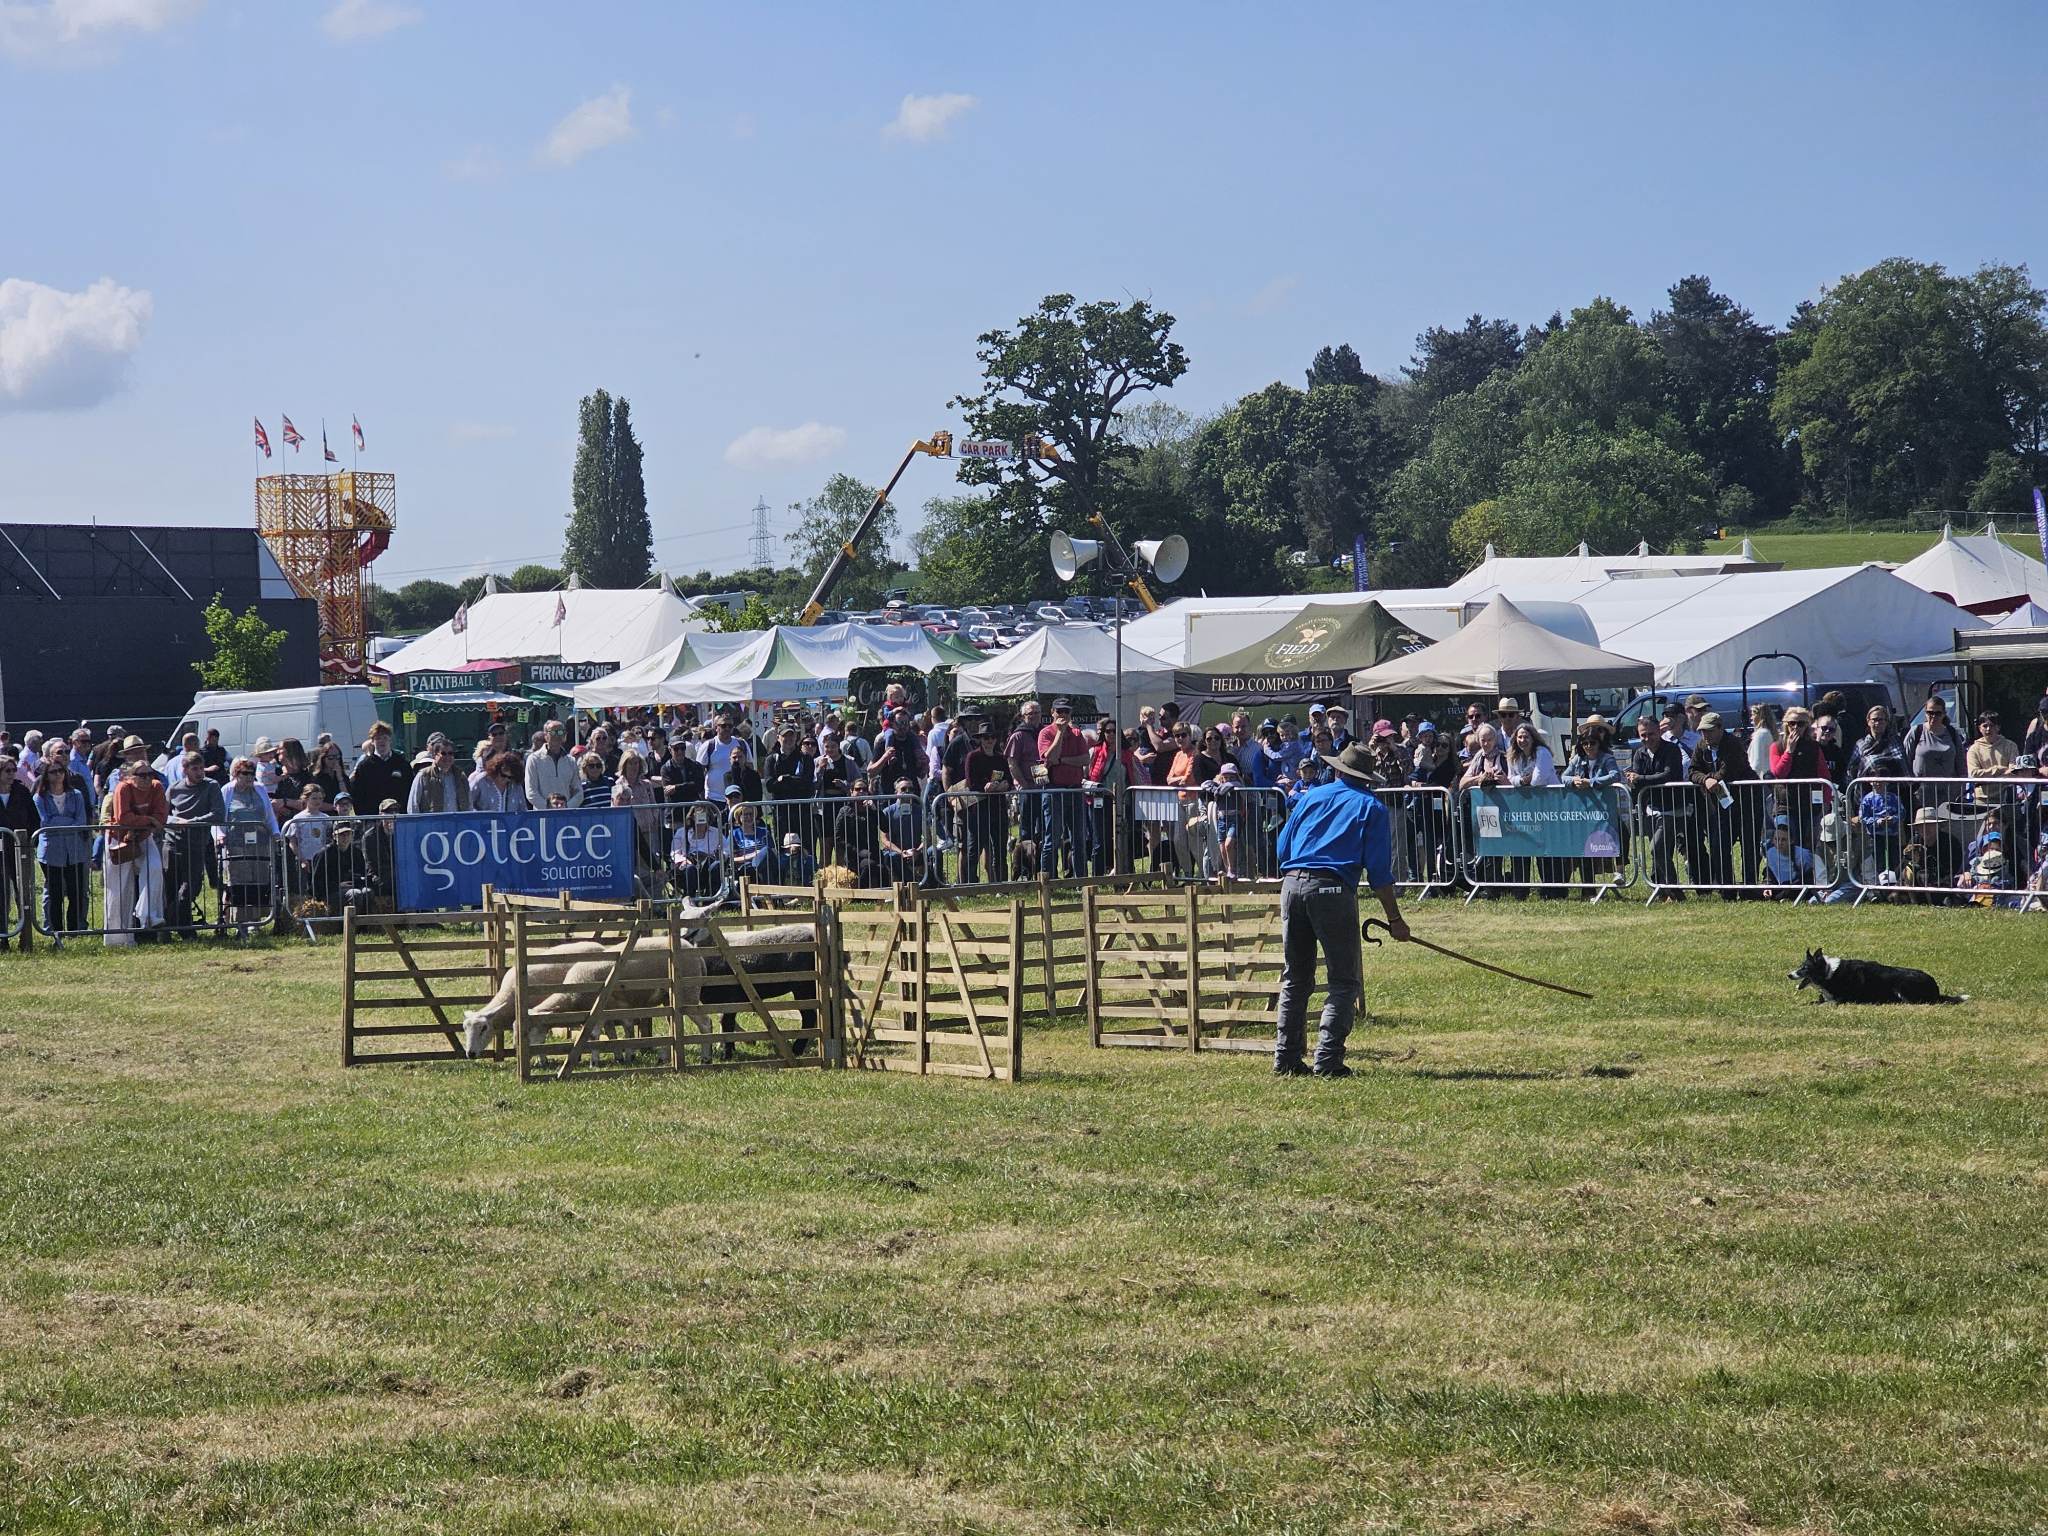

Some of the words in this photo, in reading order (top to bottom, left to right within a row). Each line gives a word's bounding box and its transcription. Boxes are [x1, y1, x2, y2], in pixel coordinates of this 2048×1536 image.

[961, 443, 980, 454] CAR
[982, 444, 1008, 456] PARK
[1274, 643, 1320, 655] FIELD
[530, 665, 574, 681] FIRING
[576, 664, 612, 680] ZONE
[409, 675, 474, 692] PAINTBALL
[1211, 678, 1245, 692] FIELD
[1247, 676, 1308, 692] COMPOST
[1310, 675, 1335, 690] LTD
[1480, 814, 1498, 829] FJG
[1504, 811, 1531, 822] FISHER
[1533, 811, 1558, 823] JONES
[1559, 810, 1609, 821] GREENWOOD
[420, 817, 612, 891] gotelee
[541, 865, 612, 880] SOLICITORS
